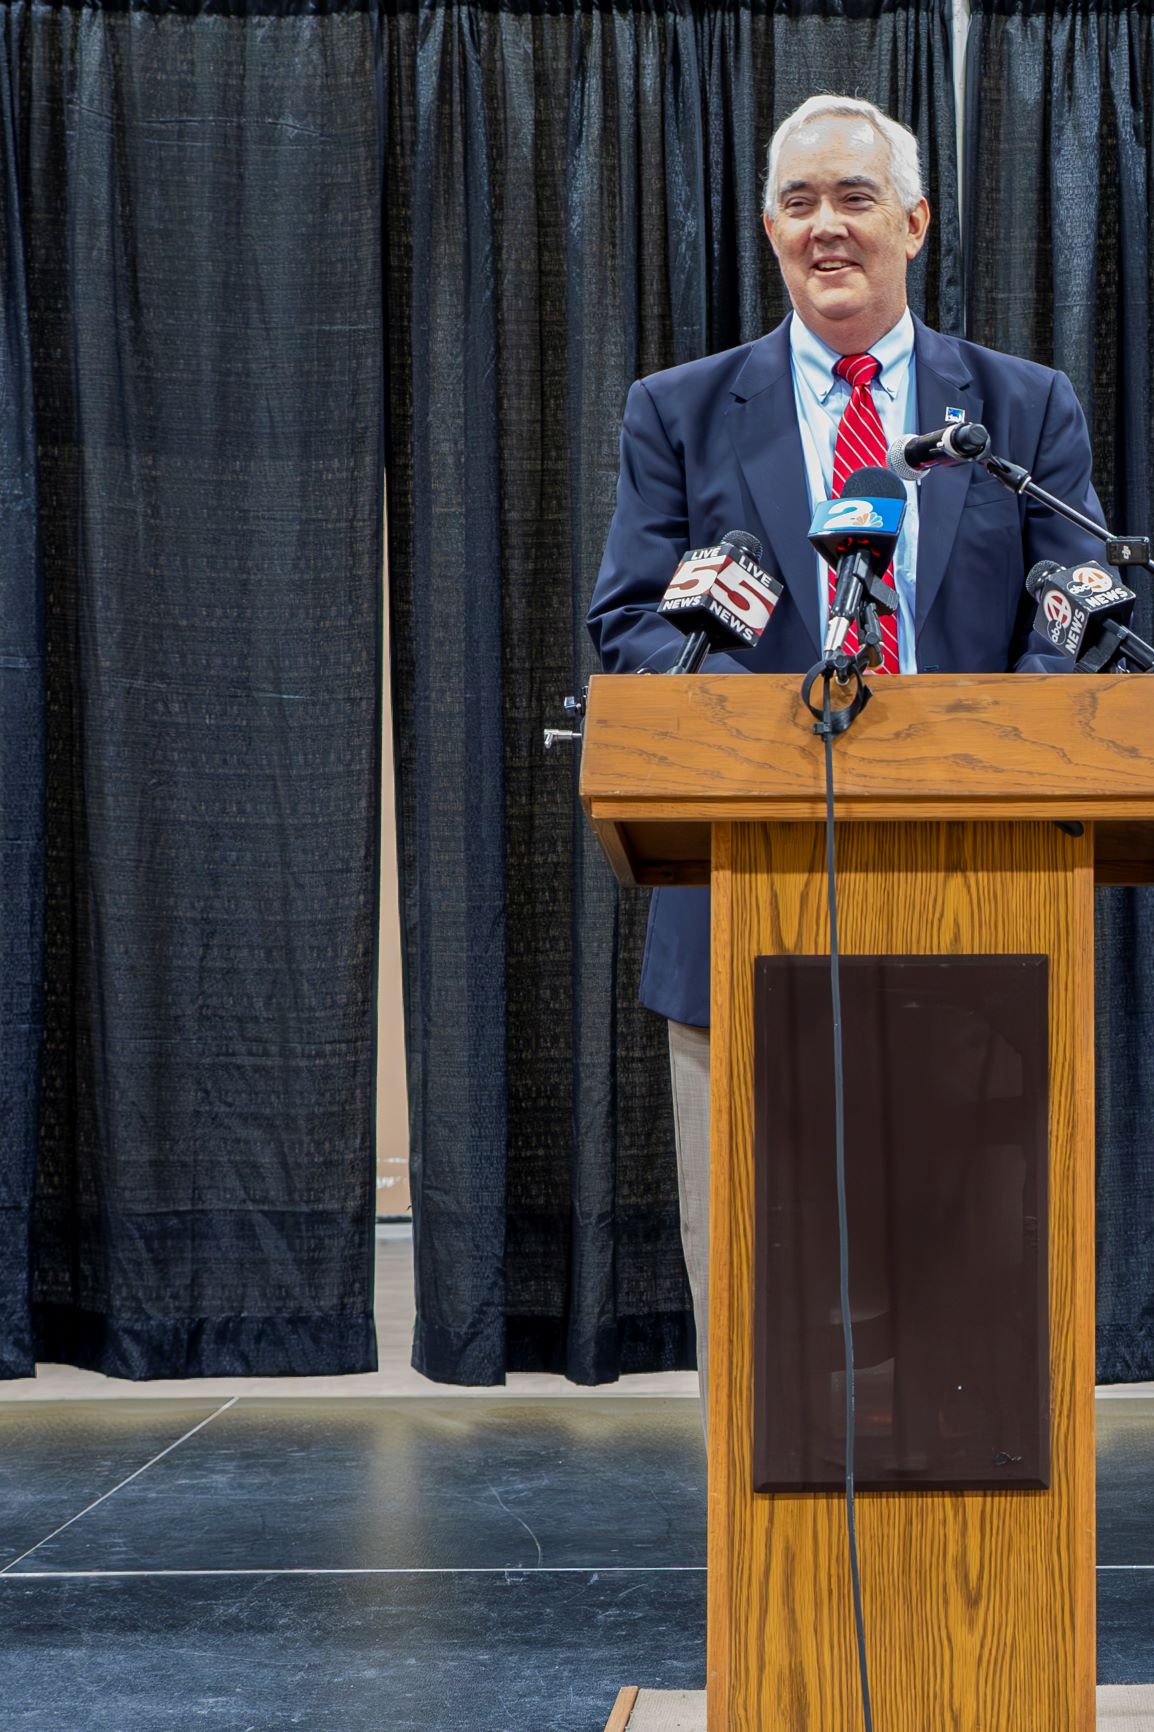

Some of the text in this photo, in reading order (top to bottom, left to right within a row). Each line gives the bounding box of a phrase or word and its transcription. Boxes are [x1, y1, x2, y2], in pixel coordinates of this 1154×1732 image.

[824, 500, 873, 529] 2
[691, 547, 721, 560] LIVE
[663, 555, 727, 600] 5
[739, 555, 772, 587] LIVE
[663, 596, 701, 610] NEWS
[709, 561, 779, 629] 5
[1069, 584, 1090, 594] abc
[1085, 587, 1128, 608] NEWS
[709, 601, 754, 640] NEWS
[1051, 620, 1062, 643] abc
[1065, 609, 1085, 654] NEWS
